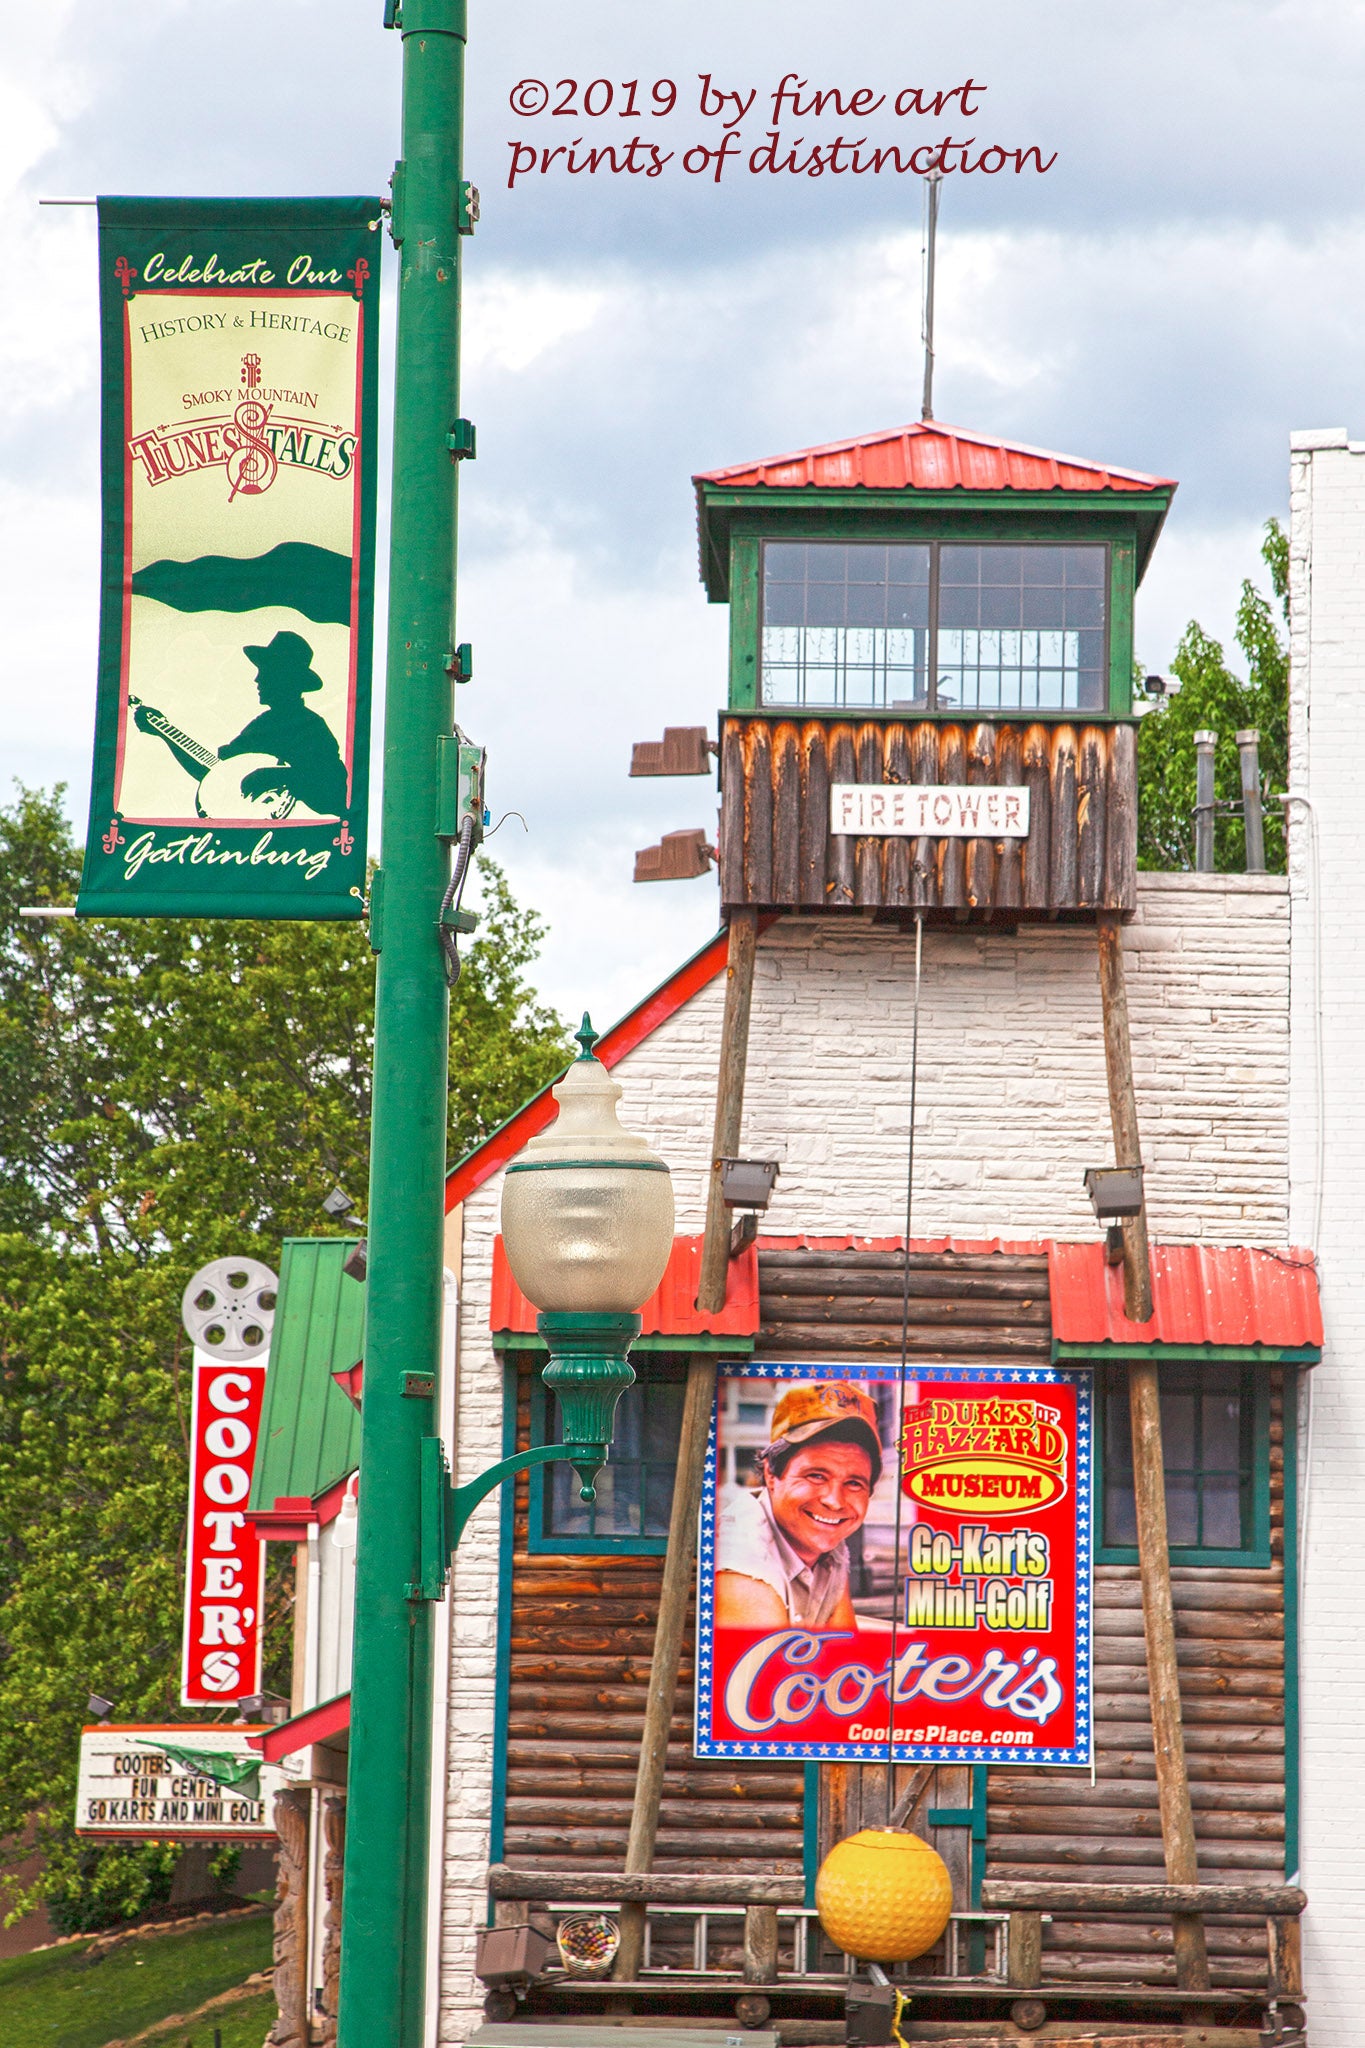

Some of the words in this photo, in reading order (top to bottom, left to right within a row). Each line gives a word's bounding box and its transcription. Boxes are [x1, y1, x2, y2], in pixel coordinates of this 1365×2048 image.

[142, 252, 276, 285] Celebrate
[286, 254, 343, 285] Our
[140, 312, 228, 344] HISTORY
[232, 315, 245, 328] &
[249, 310, 352, 344] HERITAGE
[182, 388, 233, 411] SMOKY
[237, 387, 320, 410] MOUNTAIN
[132, 426, 240, 481] TUNES
[265, 429, 358, 477] TALES
[841, 792, 905, 828] FIRE
[918, 793, 1021, 829] TOWER
[123, 831, 332, 881] Gatlinburg
[932, 1400, 1035, 1427] DUKES
[1035, 1404, 1058, 1425] OF
[901, 1422, 1067, 1475] HAZZARD
[921, 1473, 1043, 1499] MUSEUM
[198, 1372, 255, 1693] COOTER'S
[910, 1524, 1048, 1577] Go-Karts
[906, 1578, 1052, 1631] Mini-Golf
[724, 1629, 1064, 1732] Cooter's
[114, 1754, 172, 1774] COOTERS
[132, 1778, 158, 1798] FUN
[88, 1800, 106, 1820] GO
[109, 1801, 155, 1820] KARTS
[160, 1801, 189, 1821] AND
[193, 1801, 224, 1821] MINI
[230, 1801, 265, 1822] GOLF
